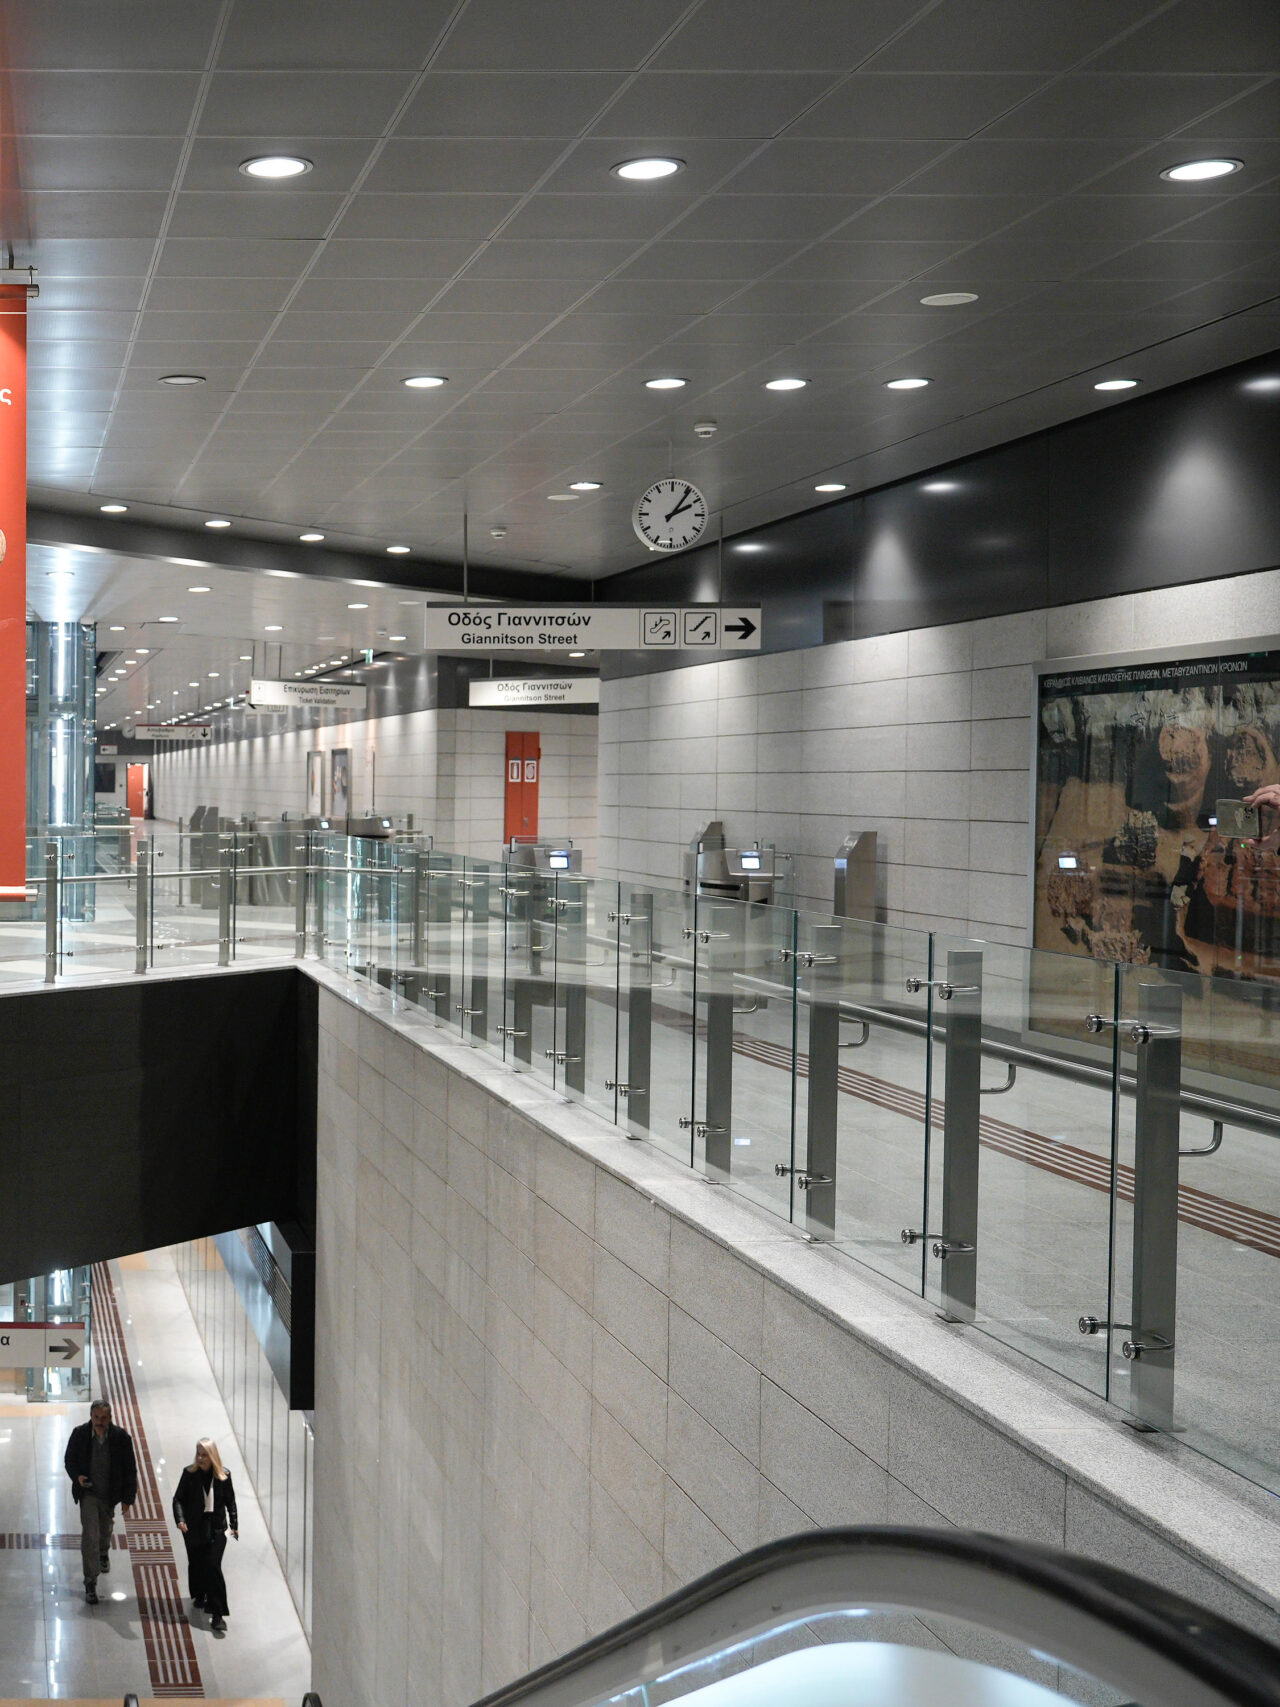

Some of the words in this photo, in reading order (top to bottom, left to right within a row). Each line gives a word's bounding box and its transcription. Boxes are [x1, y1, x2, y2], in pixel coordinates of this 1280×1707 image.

[448, 612, 492, 630] Οδός
[497, 612, 591, 626] Γιαννιτσών
[461, 633, 534, 644] Giannitson
[538, 633, 578, 644] Street
[497, 683, 520, 693] Οδός
[522, 682, 573, 691] Γιαννιτσών
